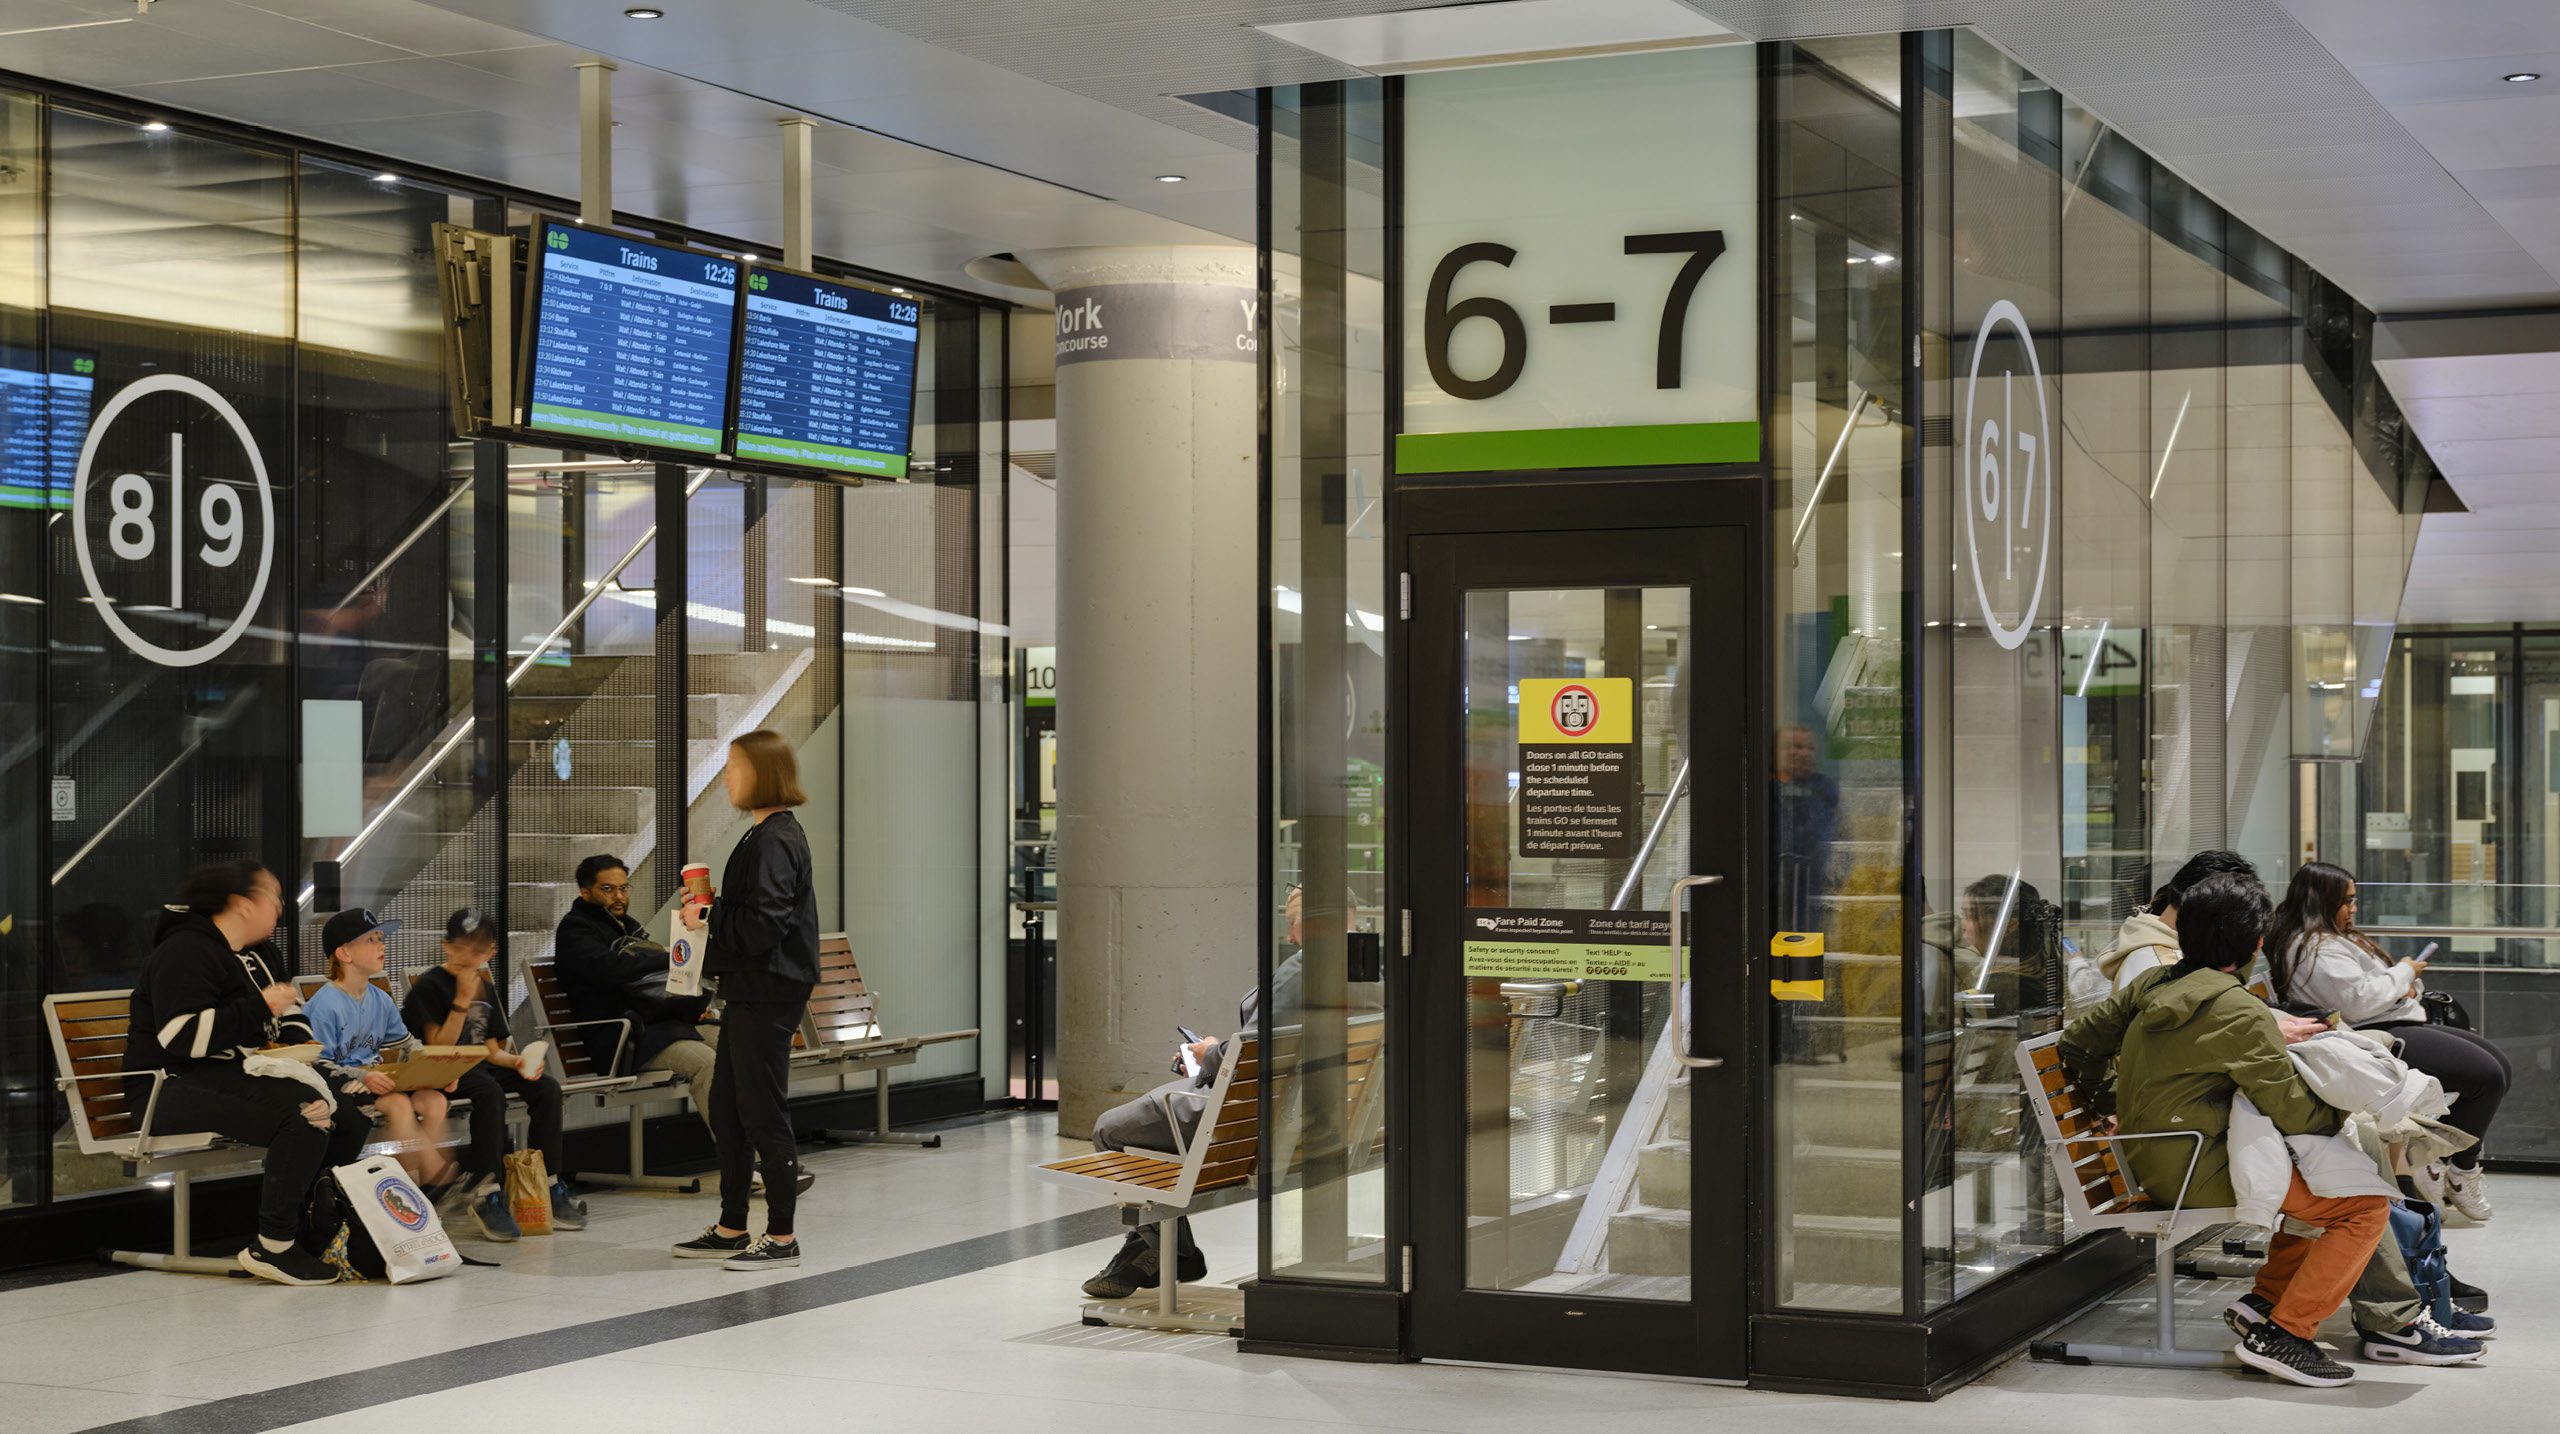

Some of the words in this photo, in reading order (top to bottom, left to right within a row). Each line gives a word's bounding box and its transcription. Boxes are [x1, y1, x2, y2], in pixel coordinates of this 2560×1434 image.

[547, 229, 569, 250] GO
[619, 247, 658, 271] Trains
[703, 262, 734, 284] 12:26
[559, 259, 578, 270] Service
[632, 274, 661, 287] Information
[690, 286, 718, 299] Destinations
[749, 273, 768, 291] GO
[665, 295, 676, 303] Train
[813, 287, 848, 310] Trains
[658, 306, 669, 315] Train
[888, 301, 916, 322] 12:26
[1424, 230, 1727, 400] 6-7
[760, 301, 777, 311] Service
[824, 314, 850, 325] Information
[876, 324, 902, 335] Destinations
[1056, 298, 1103, 336] York
[657, 319, 668, 328] Train
[655, 332, 667, 340] Train
[848, 343, 858, 351] Train
[109, 474, 155, 560] 8
[200, 483, 244, 567] 9
[1526, 751, 1553, 759] Doors
[1568, 751, 1579, 759] all
[1581, 751, 1596, 759] GO
[1597, 751, 1623, 759] trains
[1526, 763, 1550, 771] close
[1558, 763, 1588, 771] minute
[1590, 763, 1619, 771] before
[1526, 776, 1541, 784] the
[1543, 776, 1588, 784] scheduled
[1526, 788, 1570, 798] departure
[1571, 788, 1594, 796] time.
[1526, 804, 1541, 812] Les
[1543, 804, 1572, 814] portes
[1573, 804, 1585, 812] de
[1554, 817, 1568, 825] GO
[1582, 817, 1618, 825] ferment
[1526, 829, 1531, 837] 1
[1533, 829, 1563, 837] minute
[1591, 829, 1622, 837] l'heure
[1526, 841, 1538, 849] de
[1540, 841, 1569, 851] départ
[1570, 841, 1603, 851] prévue.
[1496, 917, 1515, 926] Fare
[1518, 918, 1538, 926] Paid
[1540, 918, 1563, 926] Zone
[1590, 919, 1613, 928] Zone
[1615, 920, 1627, 928] de
[1630, 920, 1650, 928] tarif
[1469, 946, 1489, 954] Safety
[1517, 957, 1567, 965] préoccupations
